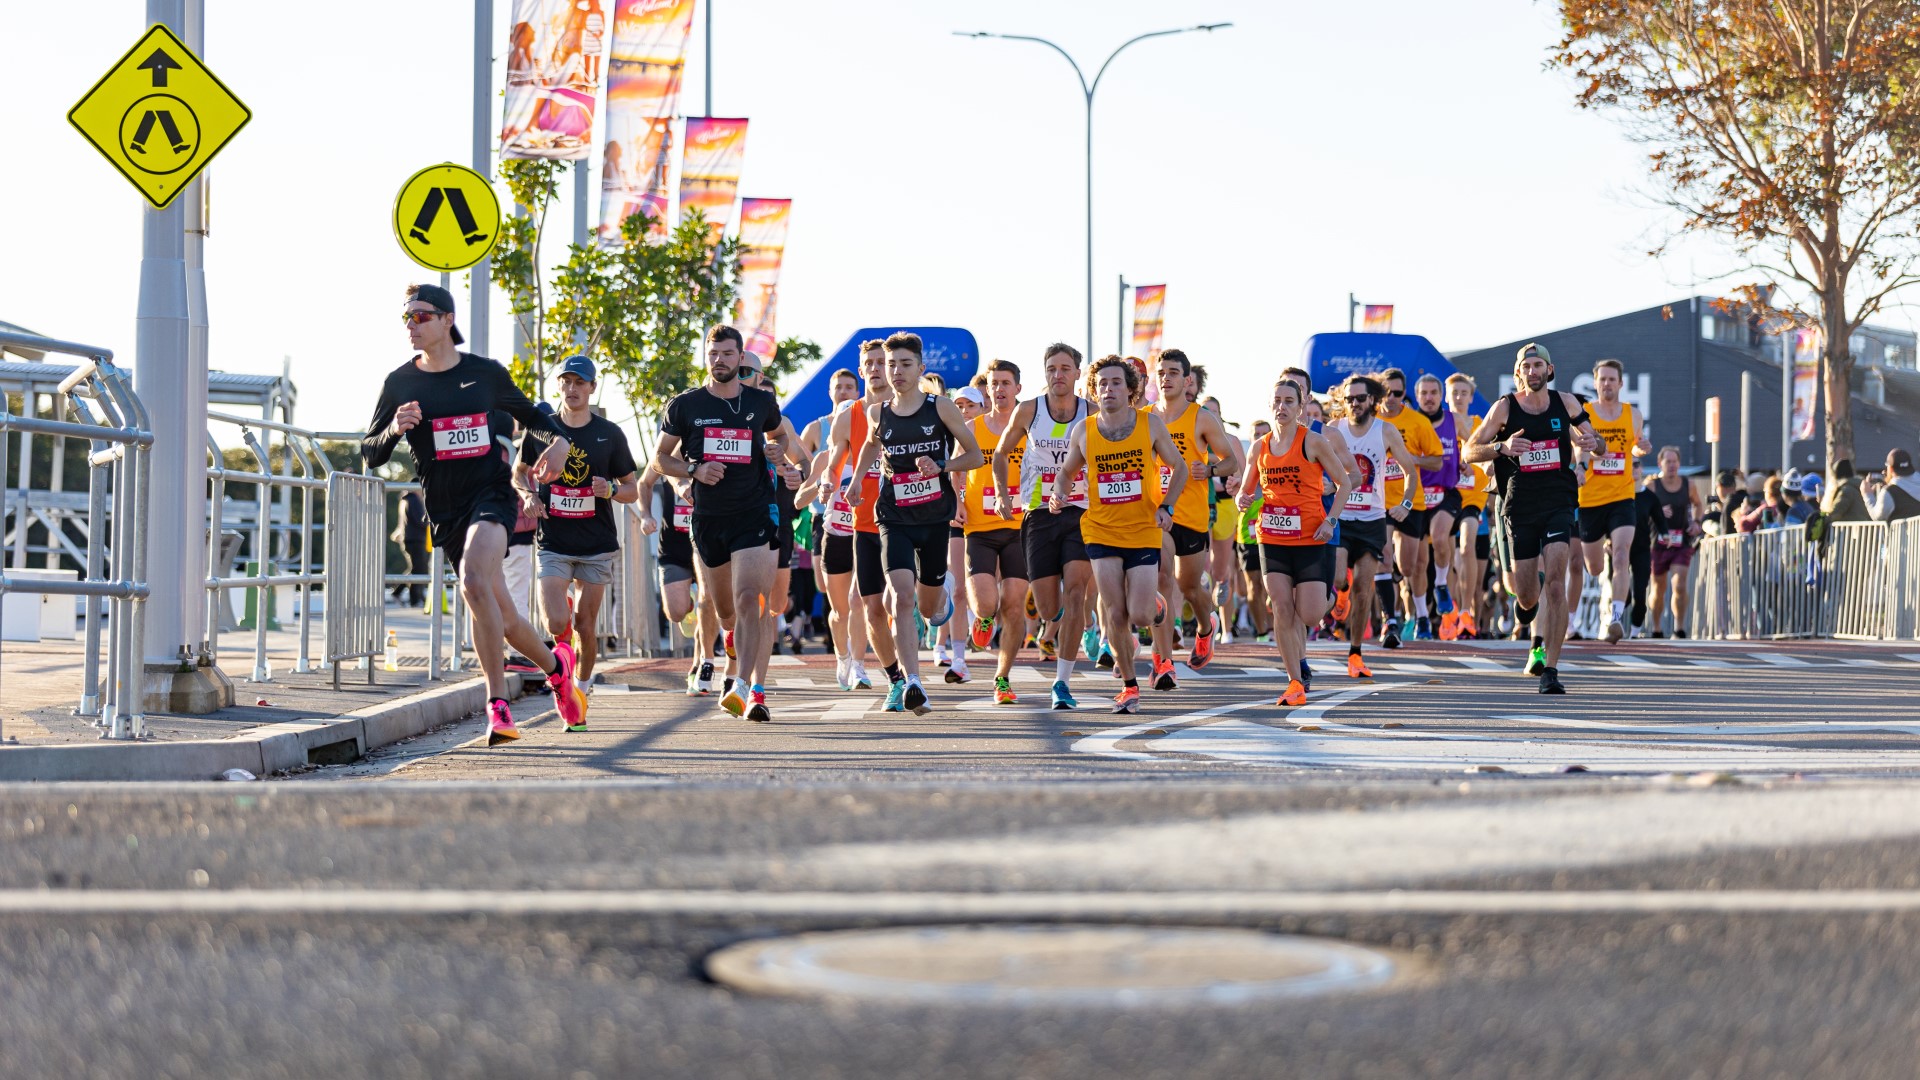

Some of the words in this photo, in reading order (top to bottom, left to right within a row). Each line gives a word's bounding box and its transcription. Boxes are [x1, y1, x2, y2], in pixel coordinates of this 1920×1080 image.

[448, 428, 479, 445] 2015
[716, 439, 739, 452] 2011
[887, 444, 907, 455] SICS
[908, 440, 941, 454] WESTS
[1035, 439, 1070, 449] ACHIEV
[1528, 450, 1551, 462] 3031
[1097, 461, 1129, 473] Shop
[1600, 459, 1619, 468] 4516
[902, 480, 932, 495] 2004
[1107, 481, 1131, 495] 2013
[560, 497, 585, 509] 4177
[1349, 493, 1364, 502] 175
[1424, 493, 1438, 502] 024
[840, 512, 853, 523] 20
[1269, 514, 1292, 527] 2026
